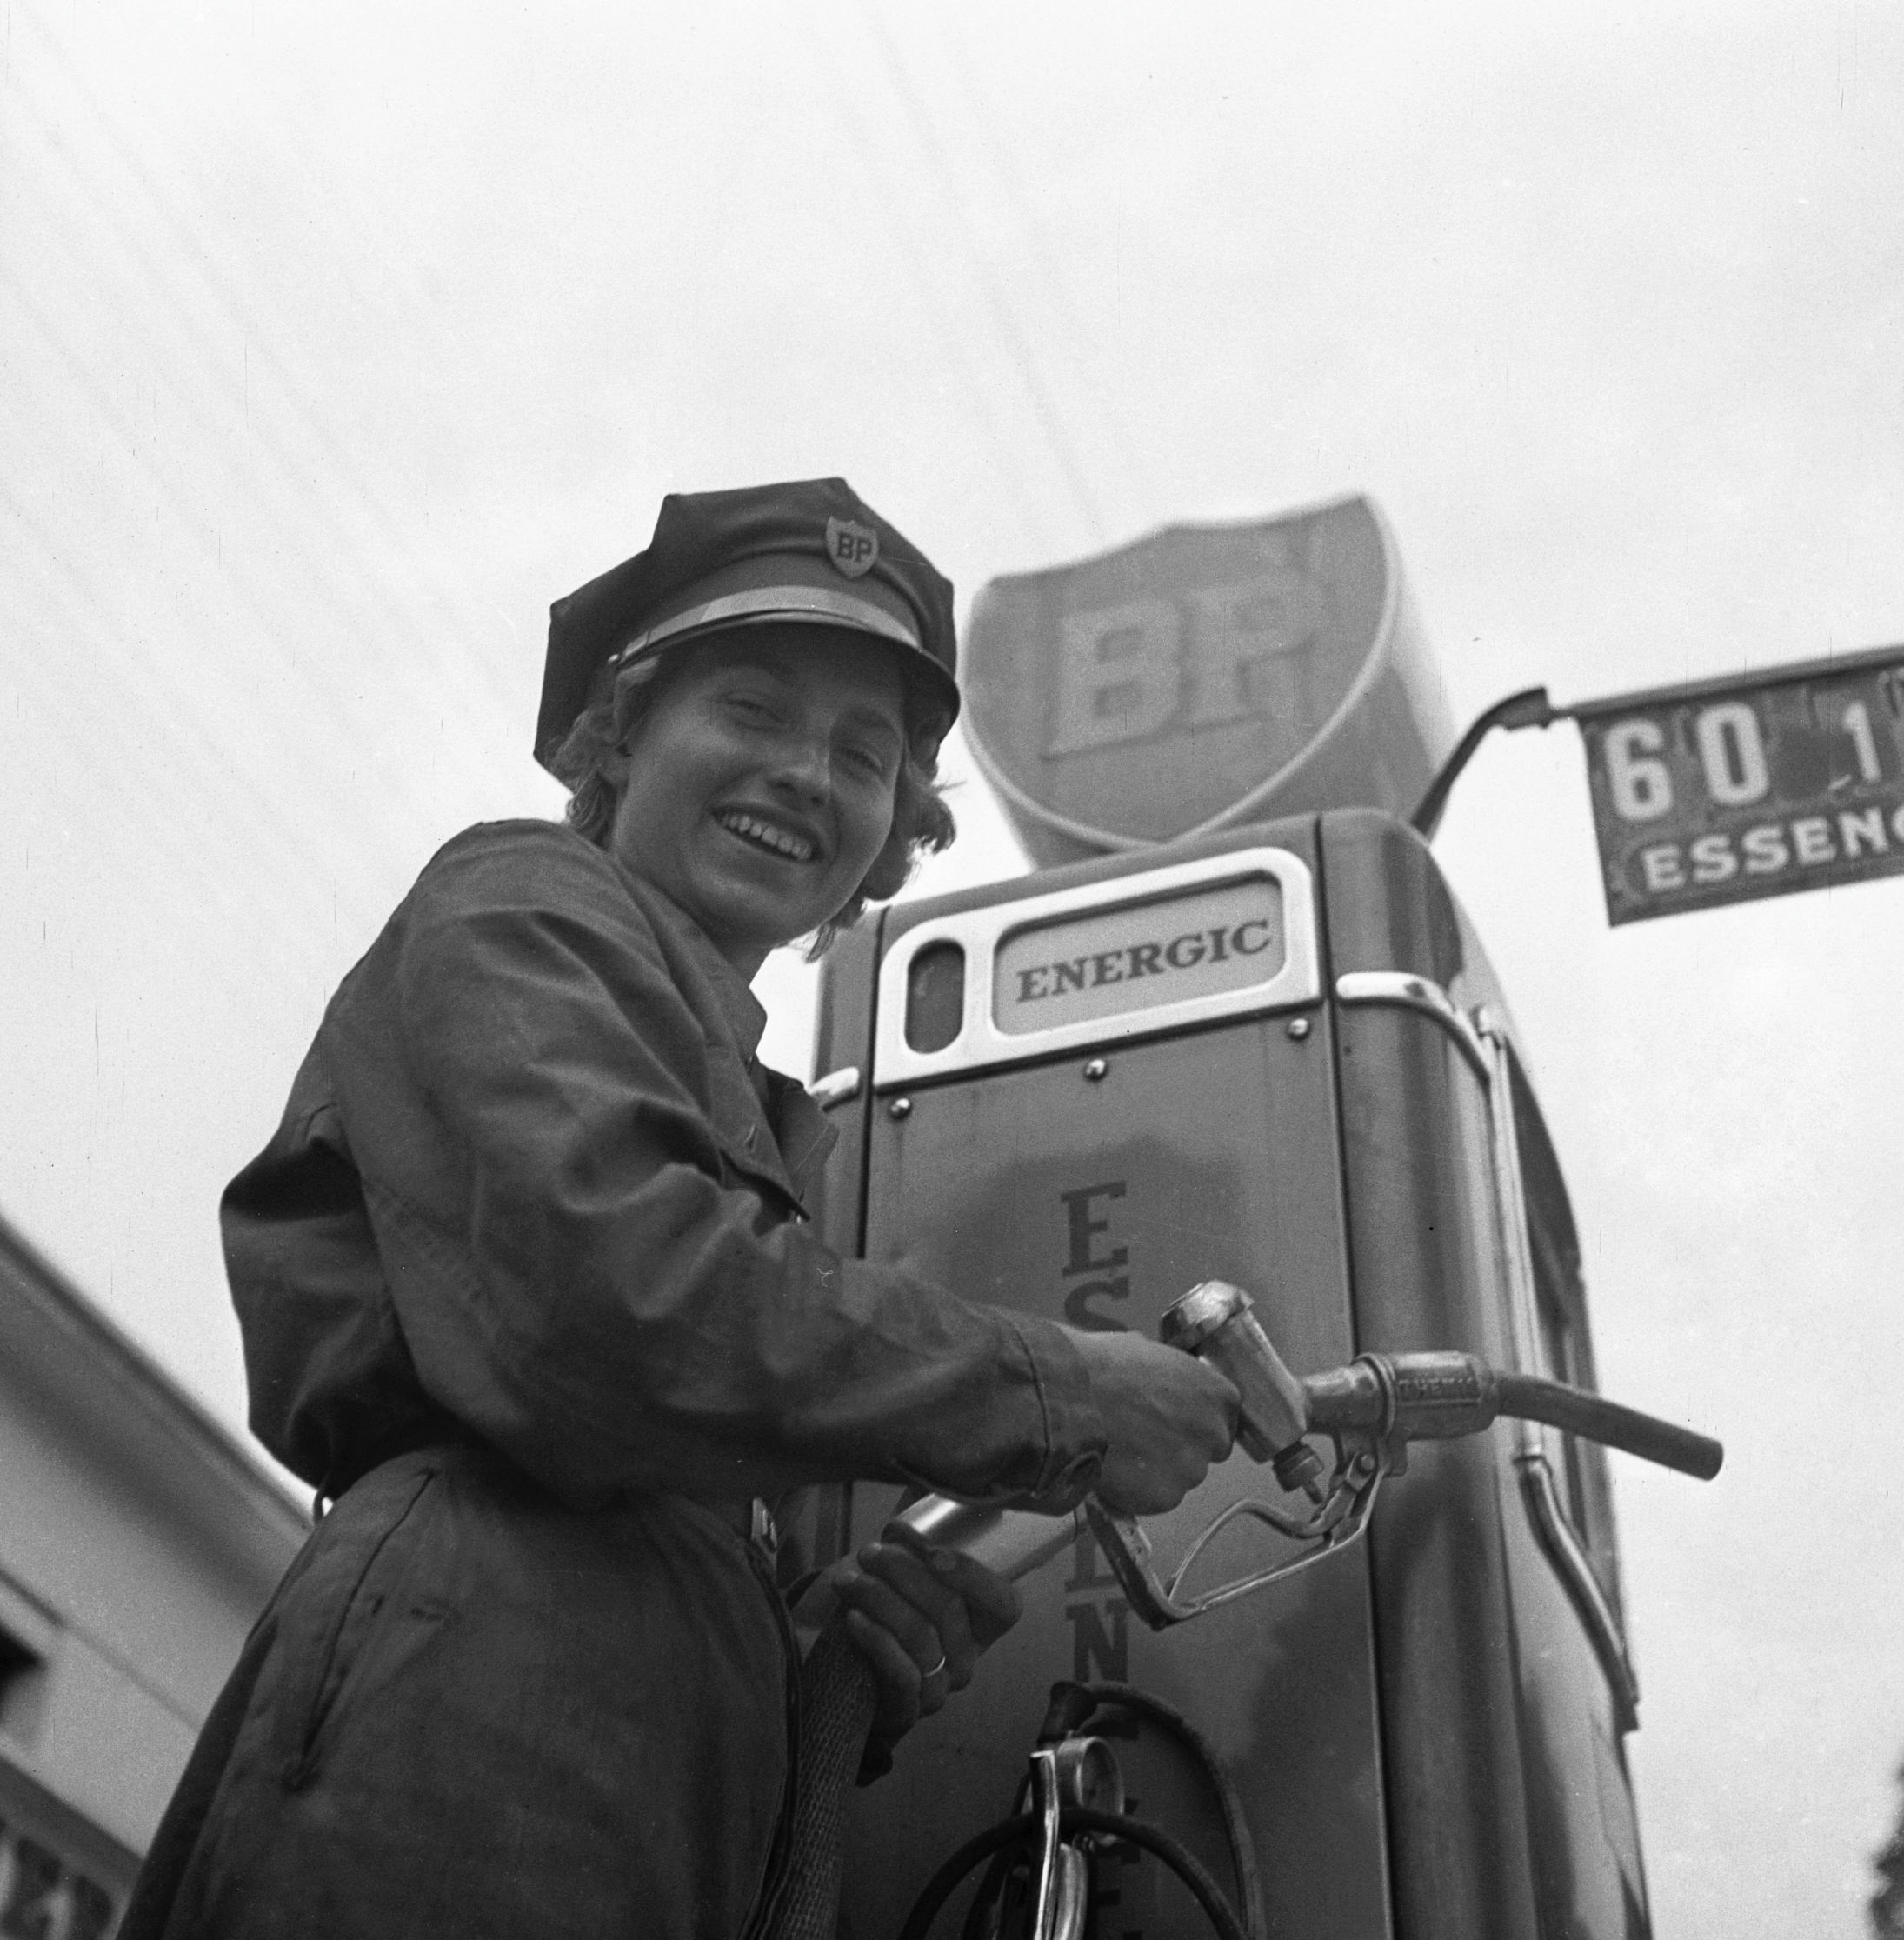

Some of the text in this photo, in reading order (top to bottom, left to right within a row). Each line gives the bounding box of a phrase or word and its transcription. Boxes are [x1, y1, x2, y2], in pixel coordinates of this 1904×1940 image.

[837, 531, 873, 563] BP
[1048, 574, 1323, 754] BP
[1604, 701, 1770, 821] 60
[1641, 804, 1904, 892] ESSEN
[1015, 918, 1271, 1003] ENERGIC
